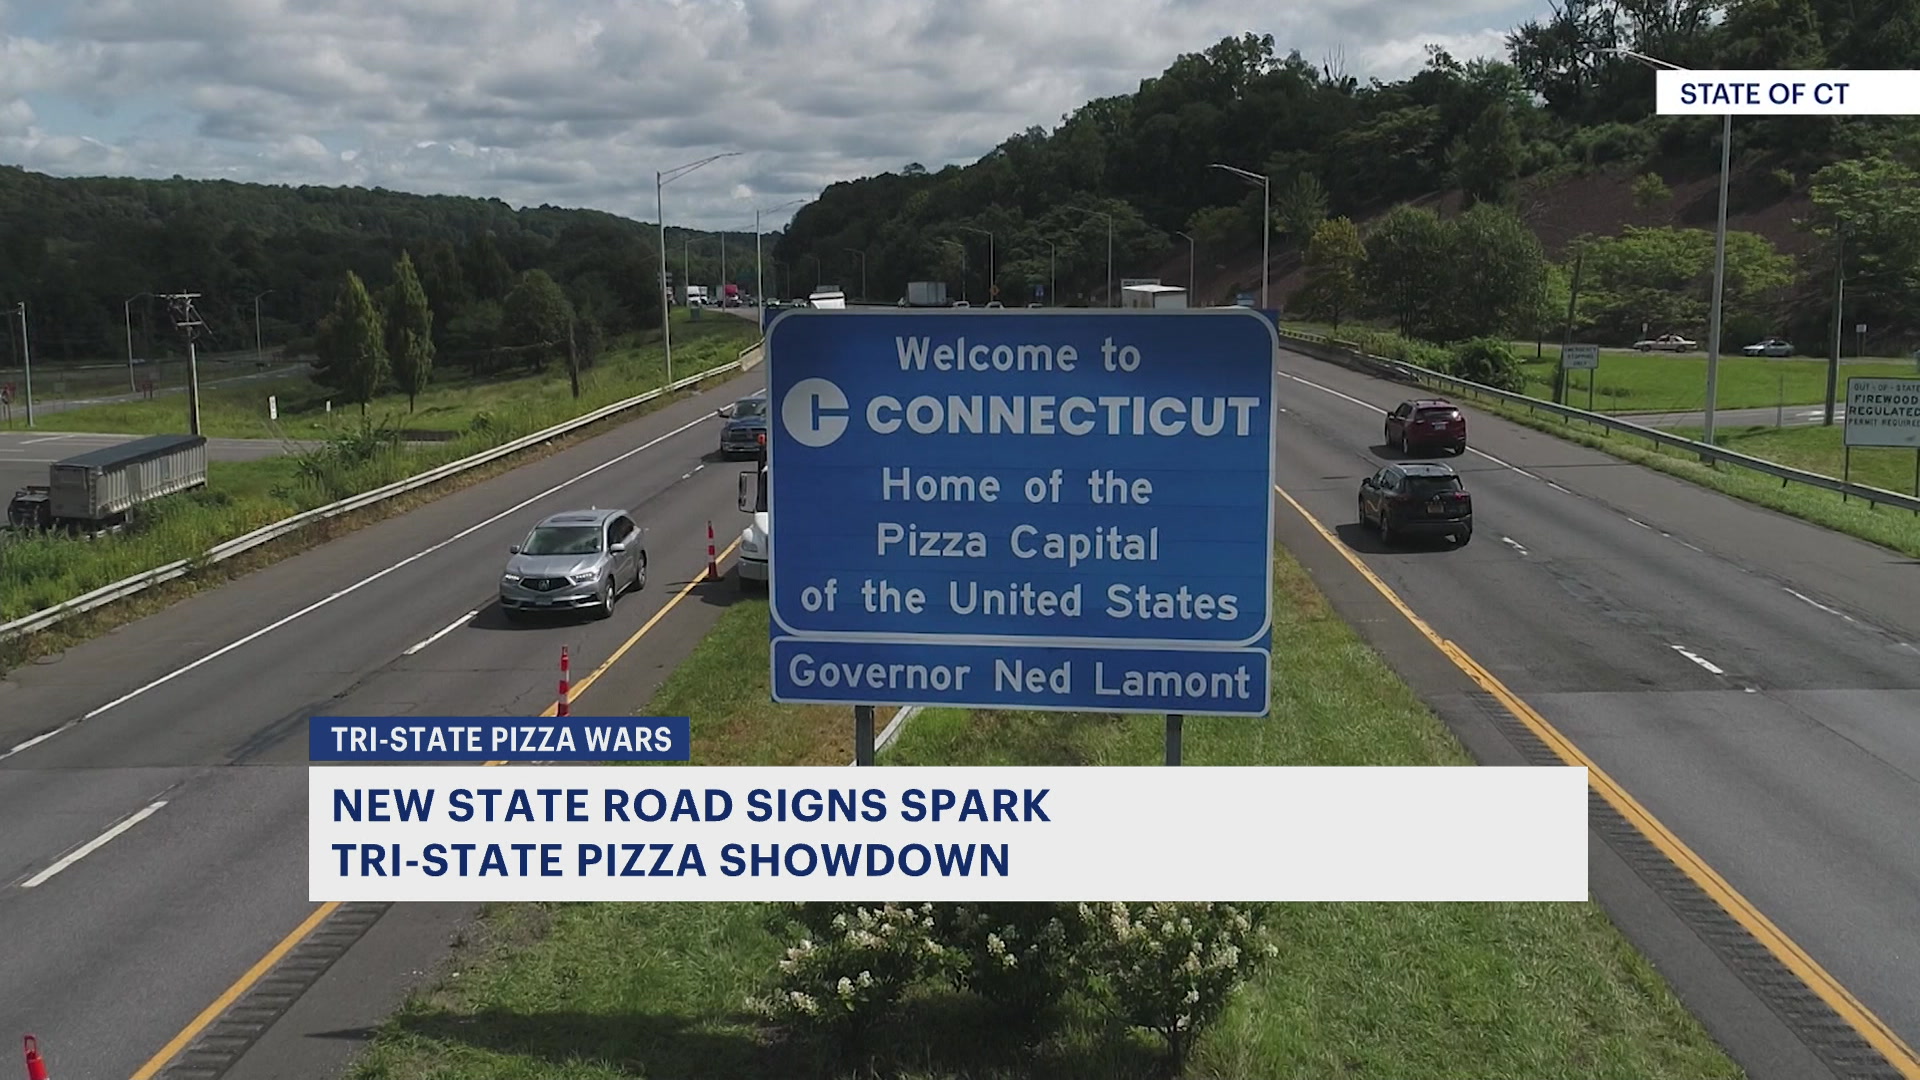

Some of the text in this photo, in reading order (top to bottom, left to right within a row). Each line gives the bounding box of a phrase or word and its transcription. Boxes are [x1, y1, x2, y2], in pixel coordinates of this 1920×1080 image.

[896, 336, 1141, 373] Welcome to
[866, 395, 1260, 437] CONNECTICUT
[1849, 406, 1920, 417] REGULATED
[1854, 394, 1919, 405] FIREWOOD
[1848, 418, 1877, 427] PERMIT
[883, 466, 1154, 505] Home of the
[877, 522, 1160, 568] Pizza Capital
[801, 578, 1239, 621] of the United States
[789, 654, 1251, 700] Governor Ned Lamont
